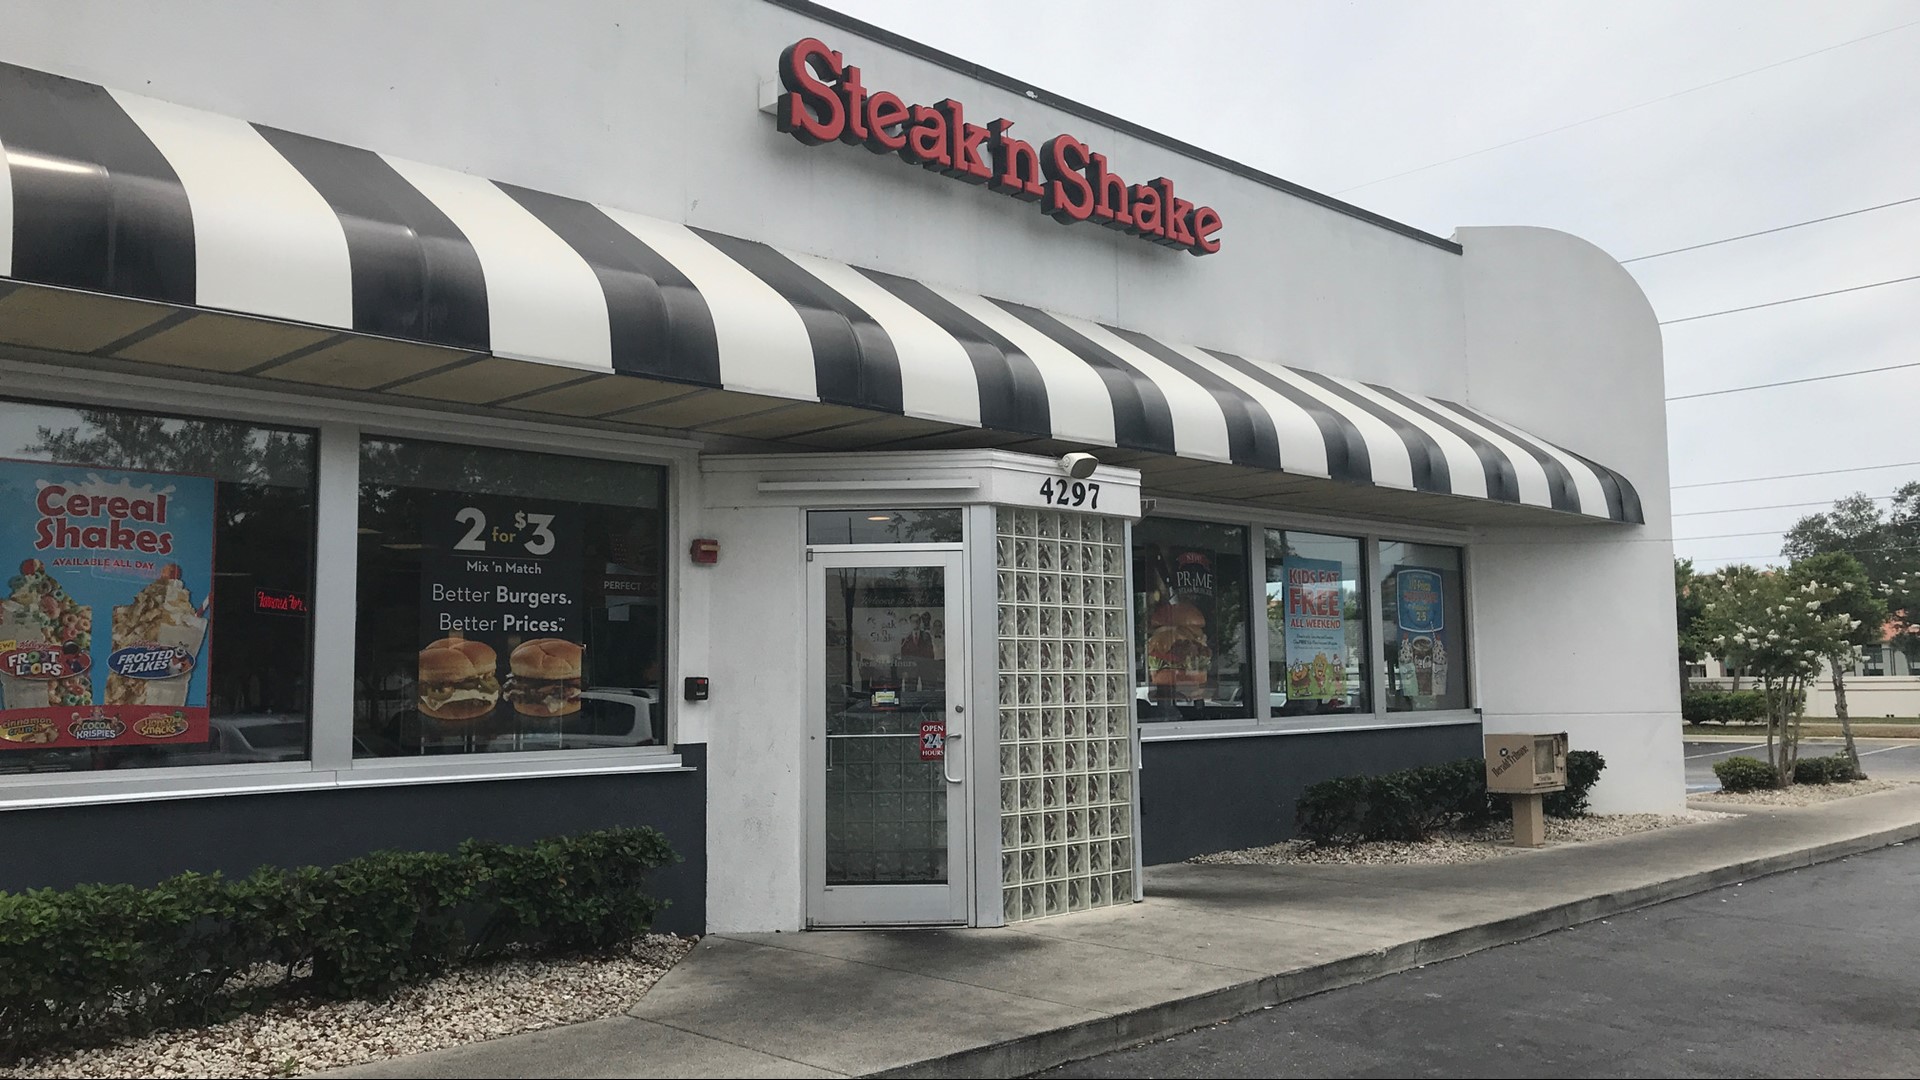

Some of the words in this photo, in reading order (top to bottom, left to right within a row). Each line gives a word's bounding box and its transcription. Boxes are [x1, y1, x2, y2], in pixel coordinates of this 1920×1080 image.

[778, 37, 993, 185] Steak
[1040, 134, 1223, 256] Shake
[1039, 476, 1100, 510] 4297
[36, 484, 168, 525] Cereal
[34, 517, 174, 555] Shakes
[453, 507, 486, 551] 2
[491, 526, 517, 543] for
[514, 509, 556, 555] $3
[52, 557, 111, 568] AVAILABLE
[112, 559, 132, 568] ALL
[134, 560, 155, 570] DAY
[466, 561, 489, 572] Mix
[505, 562, 542, 575] Match
[1289, 568, 1316, 585] KIDS
[1318, 570, 1340, 585] EAT
[603, 580, 642, 591] PERFECT
[432, 584, 491, 602] Better
[496, 585, 572, 608] Burgers.
[1289, 586, 1341, 618] FREE
[440, 613, 497, 631] Better
[1290, 618, 1304, 629] ALL
[1305, 618, 1341, 630] WEEKEND
[117, 649, 174, 665] FROSTED
[16, 662, 62, 677] LOOPS
[120, 659, 168, 675] FLAKES
[82, 721, 111, 731] COCOA
[922, 724, 944, 732] OPEN
[76, 729, 116, 740] KRISPIES
[923, 733, 943, 748] 24
